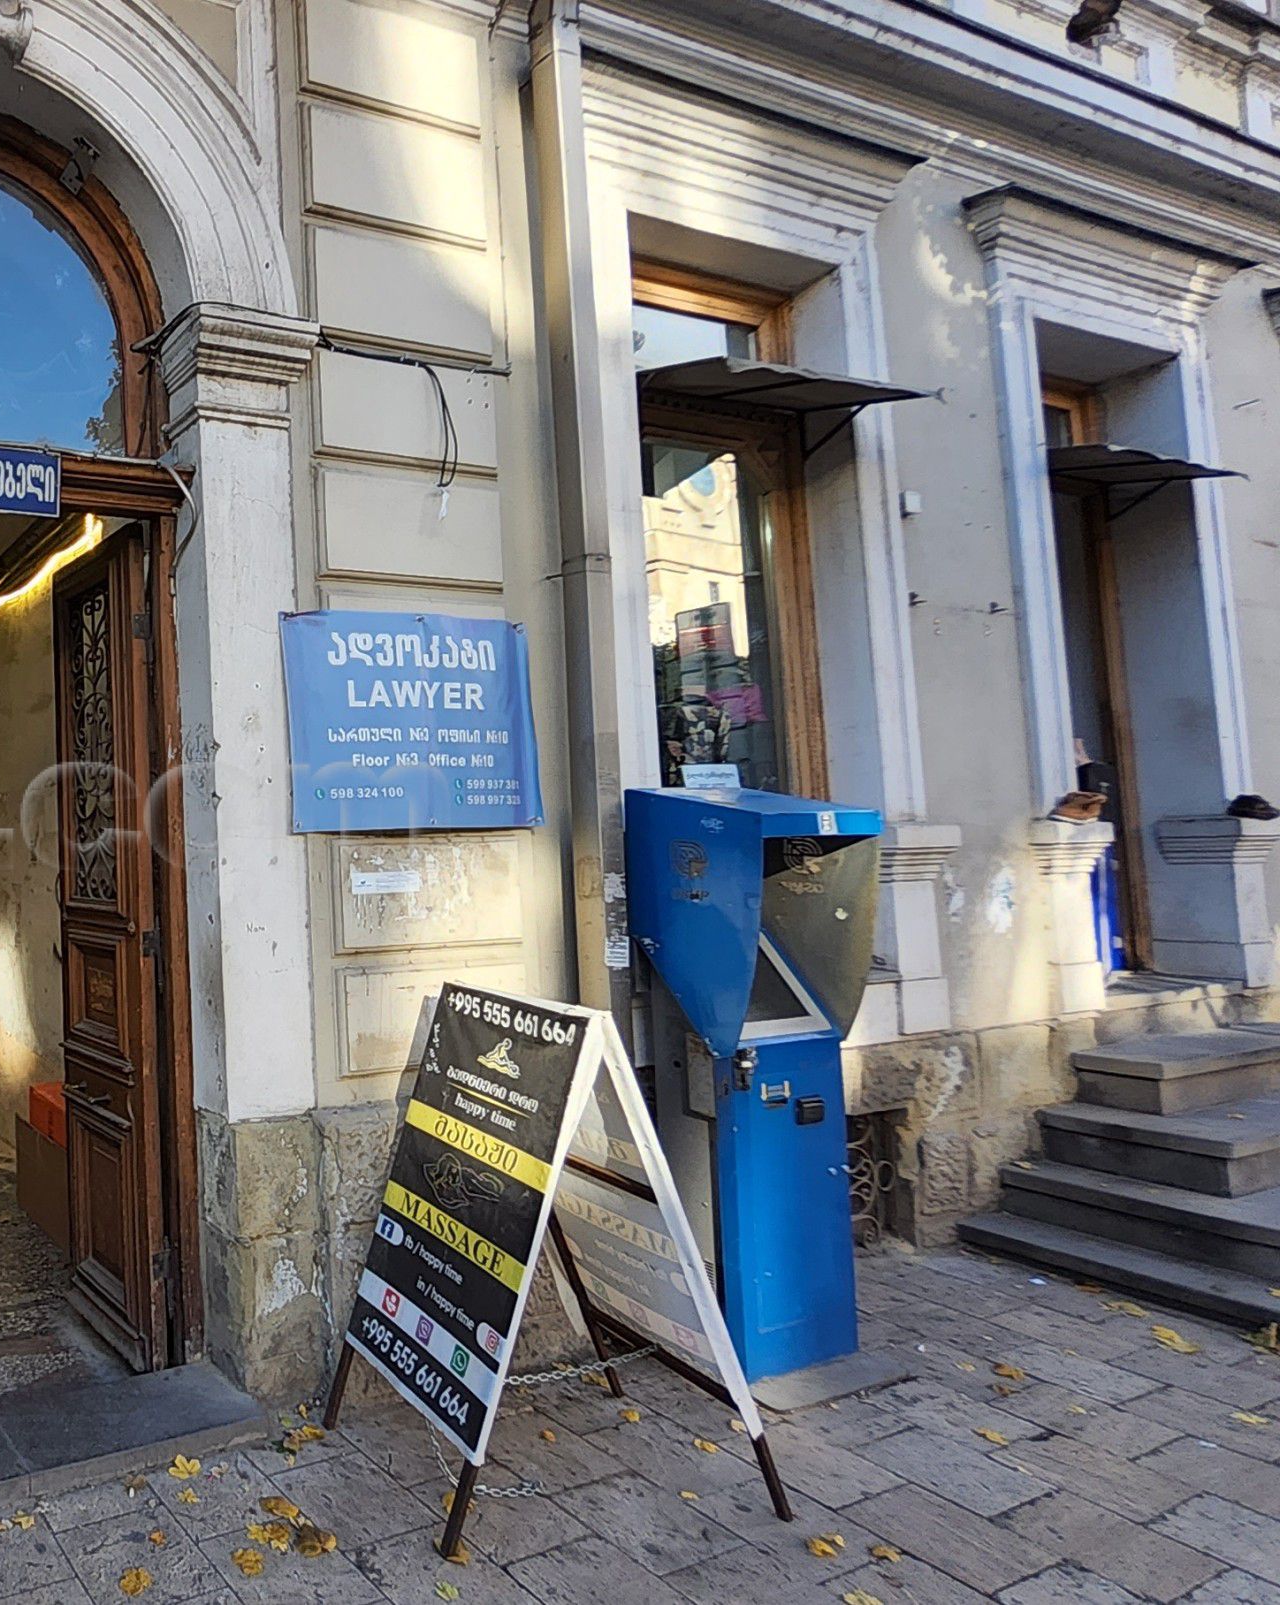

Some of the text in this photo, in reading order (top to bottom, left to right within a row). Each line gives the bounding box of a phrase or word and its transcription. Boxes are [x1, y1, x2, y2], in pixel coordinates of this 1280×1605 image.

[327, 631, 496, 672] ადვოკატი
[347, 680, 486, 711] LAWYER
[327, 727, 403, 743] სართული
[437, 728, 481, 744] ოფისი
[352, 753, 390, 767] Floor
[428, 753, 467, 767] Office
[330, 786, 404, 799] 598 324 100
[447, 991, 577, 1047] +995 555 661 664
[454, 1092, 517, 1132] happy time
[434, 1115, 519, 1172] მასაჟი
[400, 1190, 505, 1277] MASSAGE
[419, 1244, 445, 1274] happy
[444, 1263, 464, 1286] time
[430, 1286, 457, 1317] happy
[455, 1307, 475, 1331] time
[361, 1316, 470, 1426] +995 555 661 664
